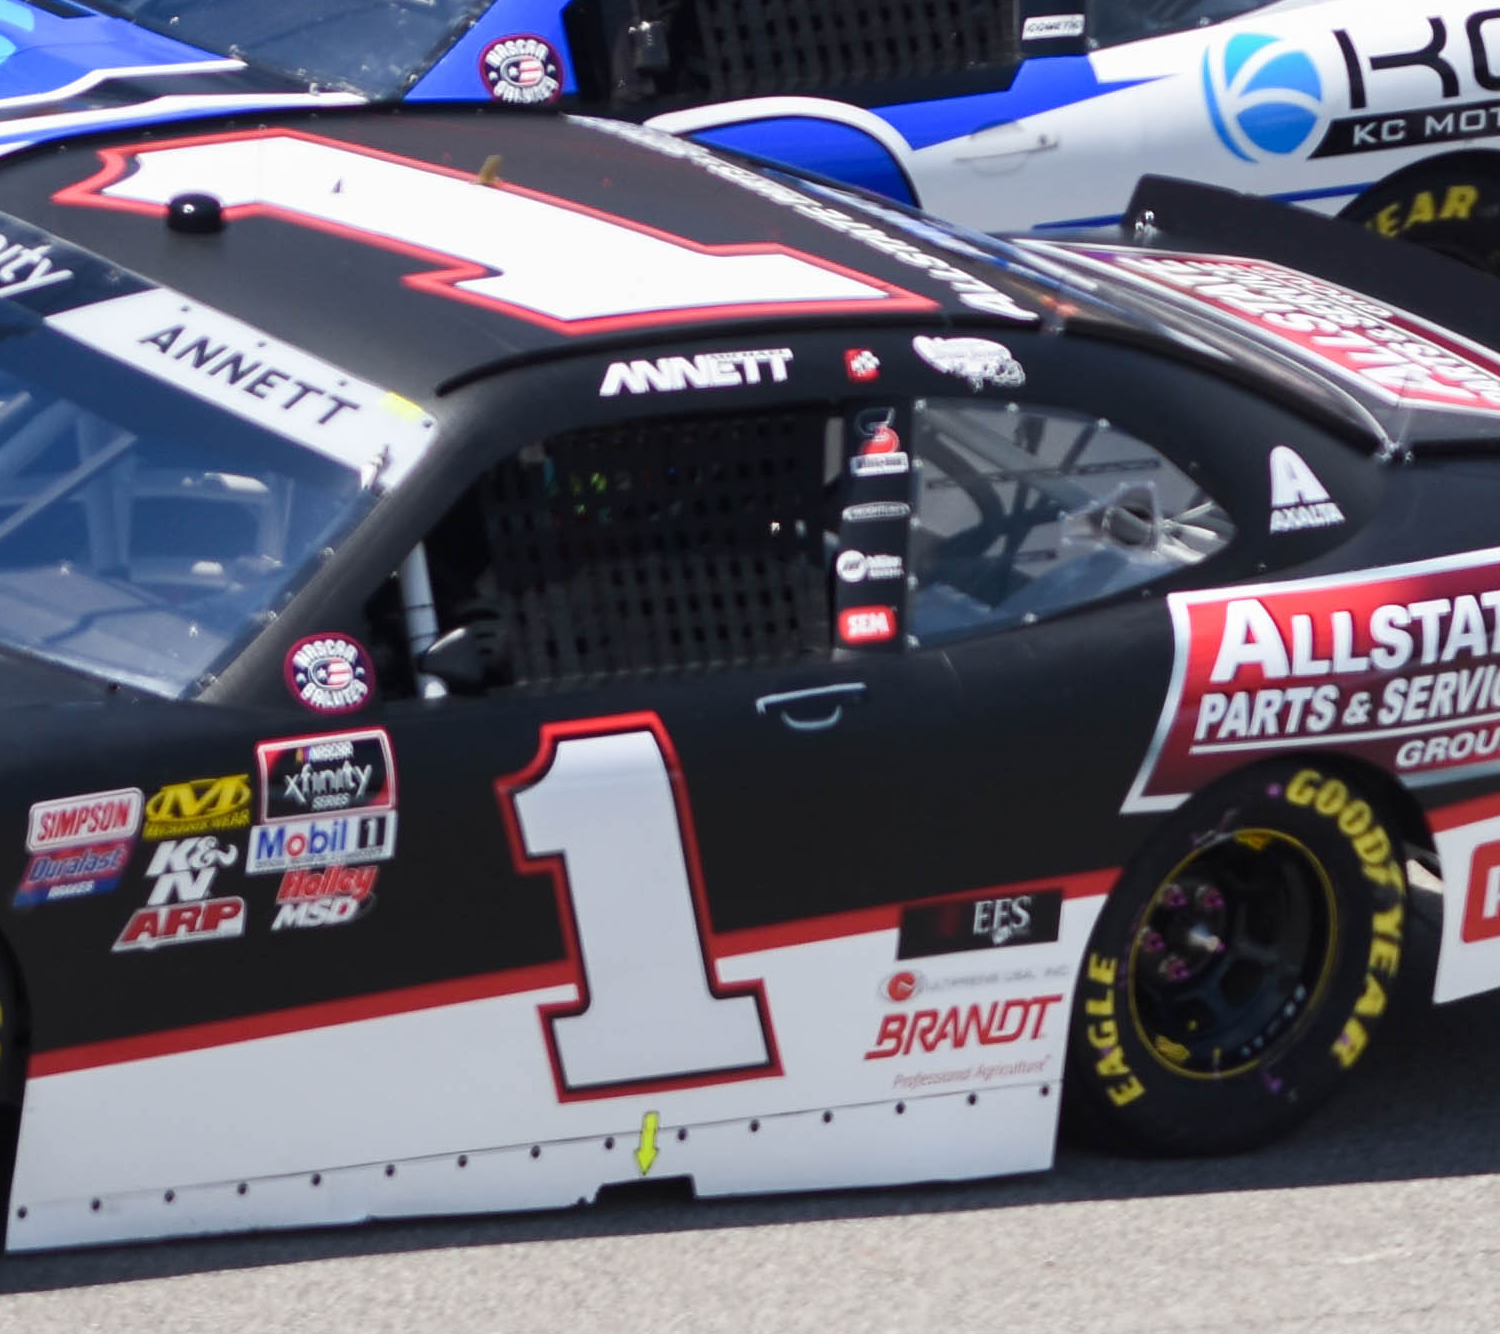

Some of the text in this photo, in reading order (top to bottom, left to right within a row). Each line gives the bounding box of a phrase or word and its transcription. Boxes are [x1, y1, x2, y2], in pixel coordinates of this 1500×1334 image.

[1353, 118, 1408, 146] KC
[52, 127, 940, 334] 1
[139, 325, 360, 427] ANNETT
[598, 347, 795, 398] ANNETT
[1268, 502, 1346, 535] AXALTA
[292, 638, 359, 670] NASCAR
[1193, 683, 1340, 741] PARTS
[1341, 690, 1374, 726] &
[306, 740, 354, 763] NASCAR
[284, 761, 373, 805] xfinity
[37, 797, 132, 842] SIMPSON
[256, 821, 348, 862] Mobil
[27, 845, 127, 883] Duralast
[276, 866, 379, 904] Holley
[121, 899, 243, 944] ARP
[271, 895, 359, 931] MSD
[493, 708, 785, 1105] 1
[1285, 767, 1408, 1070] GOODYEAR
[863, 993, 1064, 1062] BRANDT
[1085, 951, 1147, 1107] EAGLE
